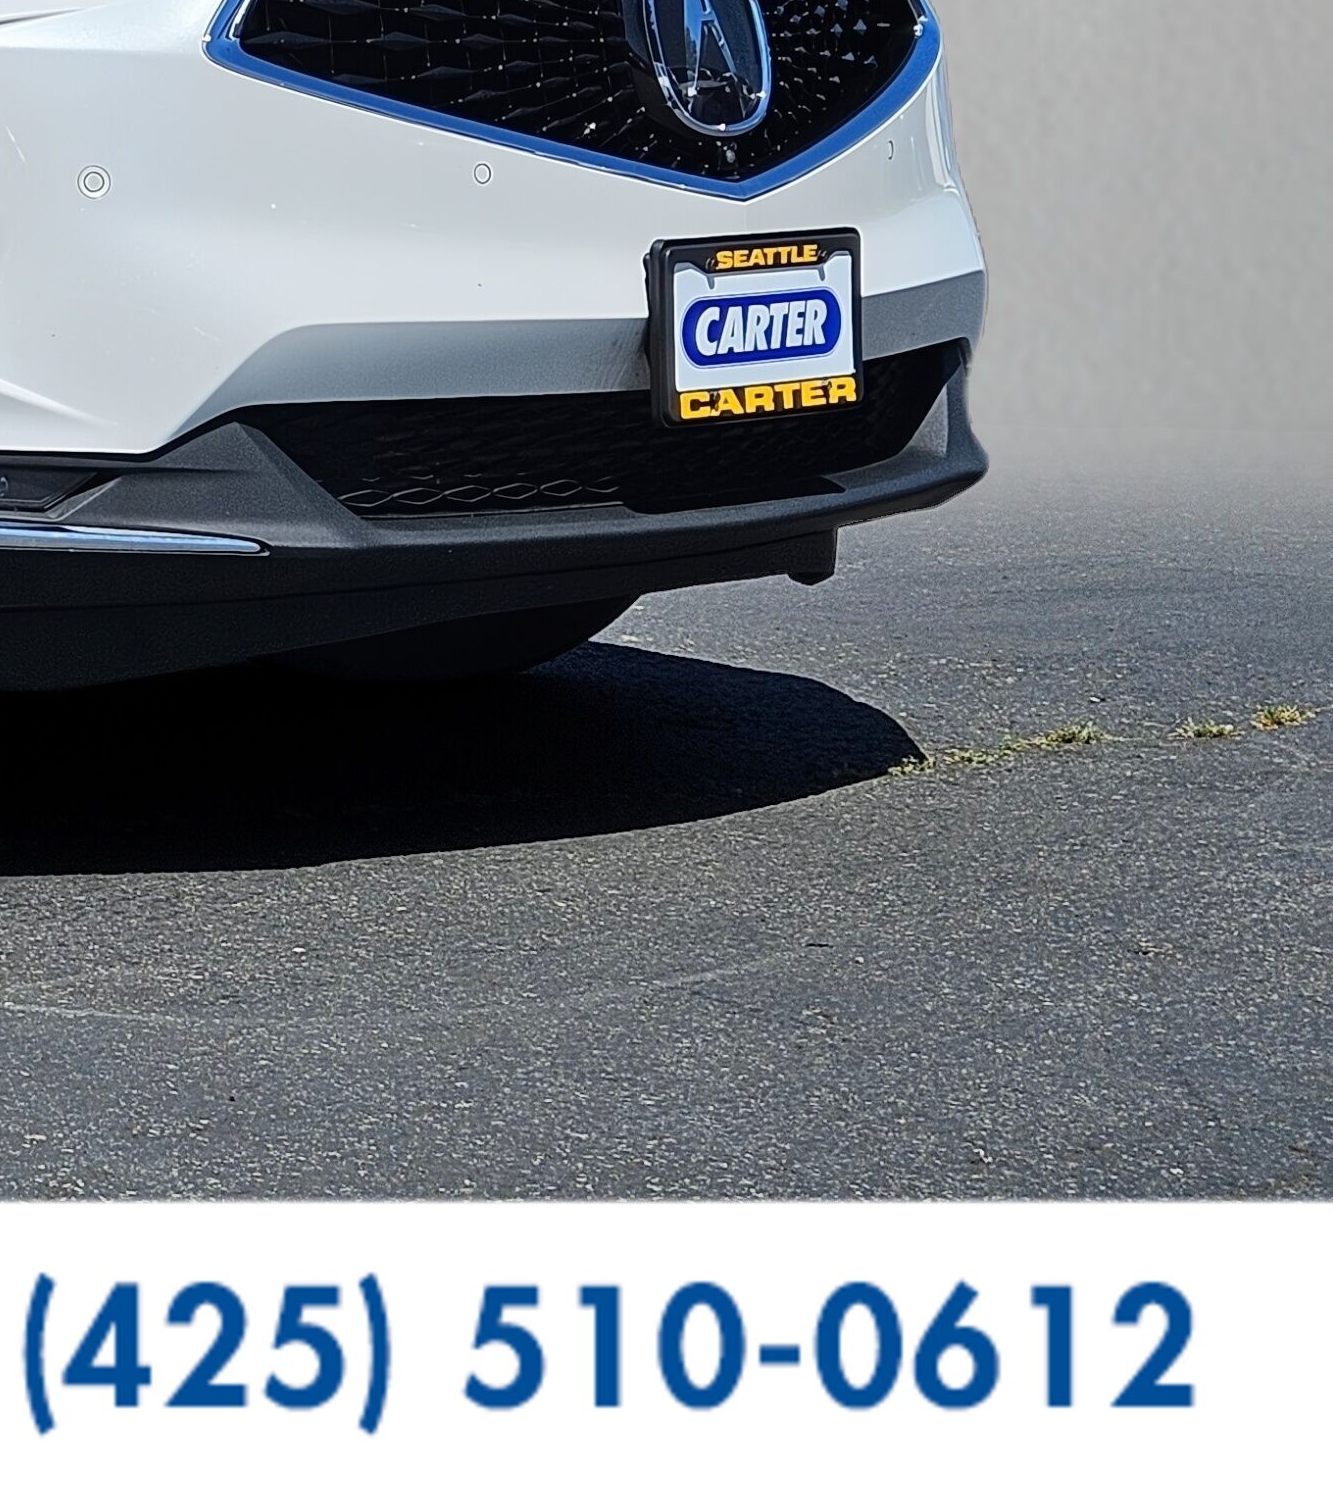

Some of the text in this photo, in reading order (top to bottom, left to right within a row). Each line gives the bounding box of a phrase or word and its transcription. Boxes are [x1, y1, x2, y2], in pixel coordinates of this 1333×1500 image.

[715, 244, 819, 270] SEATTLE
[695, 299, 827, 356] CARTER
[679, 376, 857, 420] CARTER
